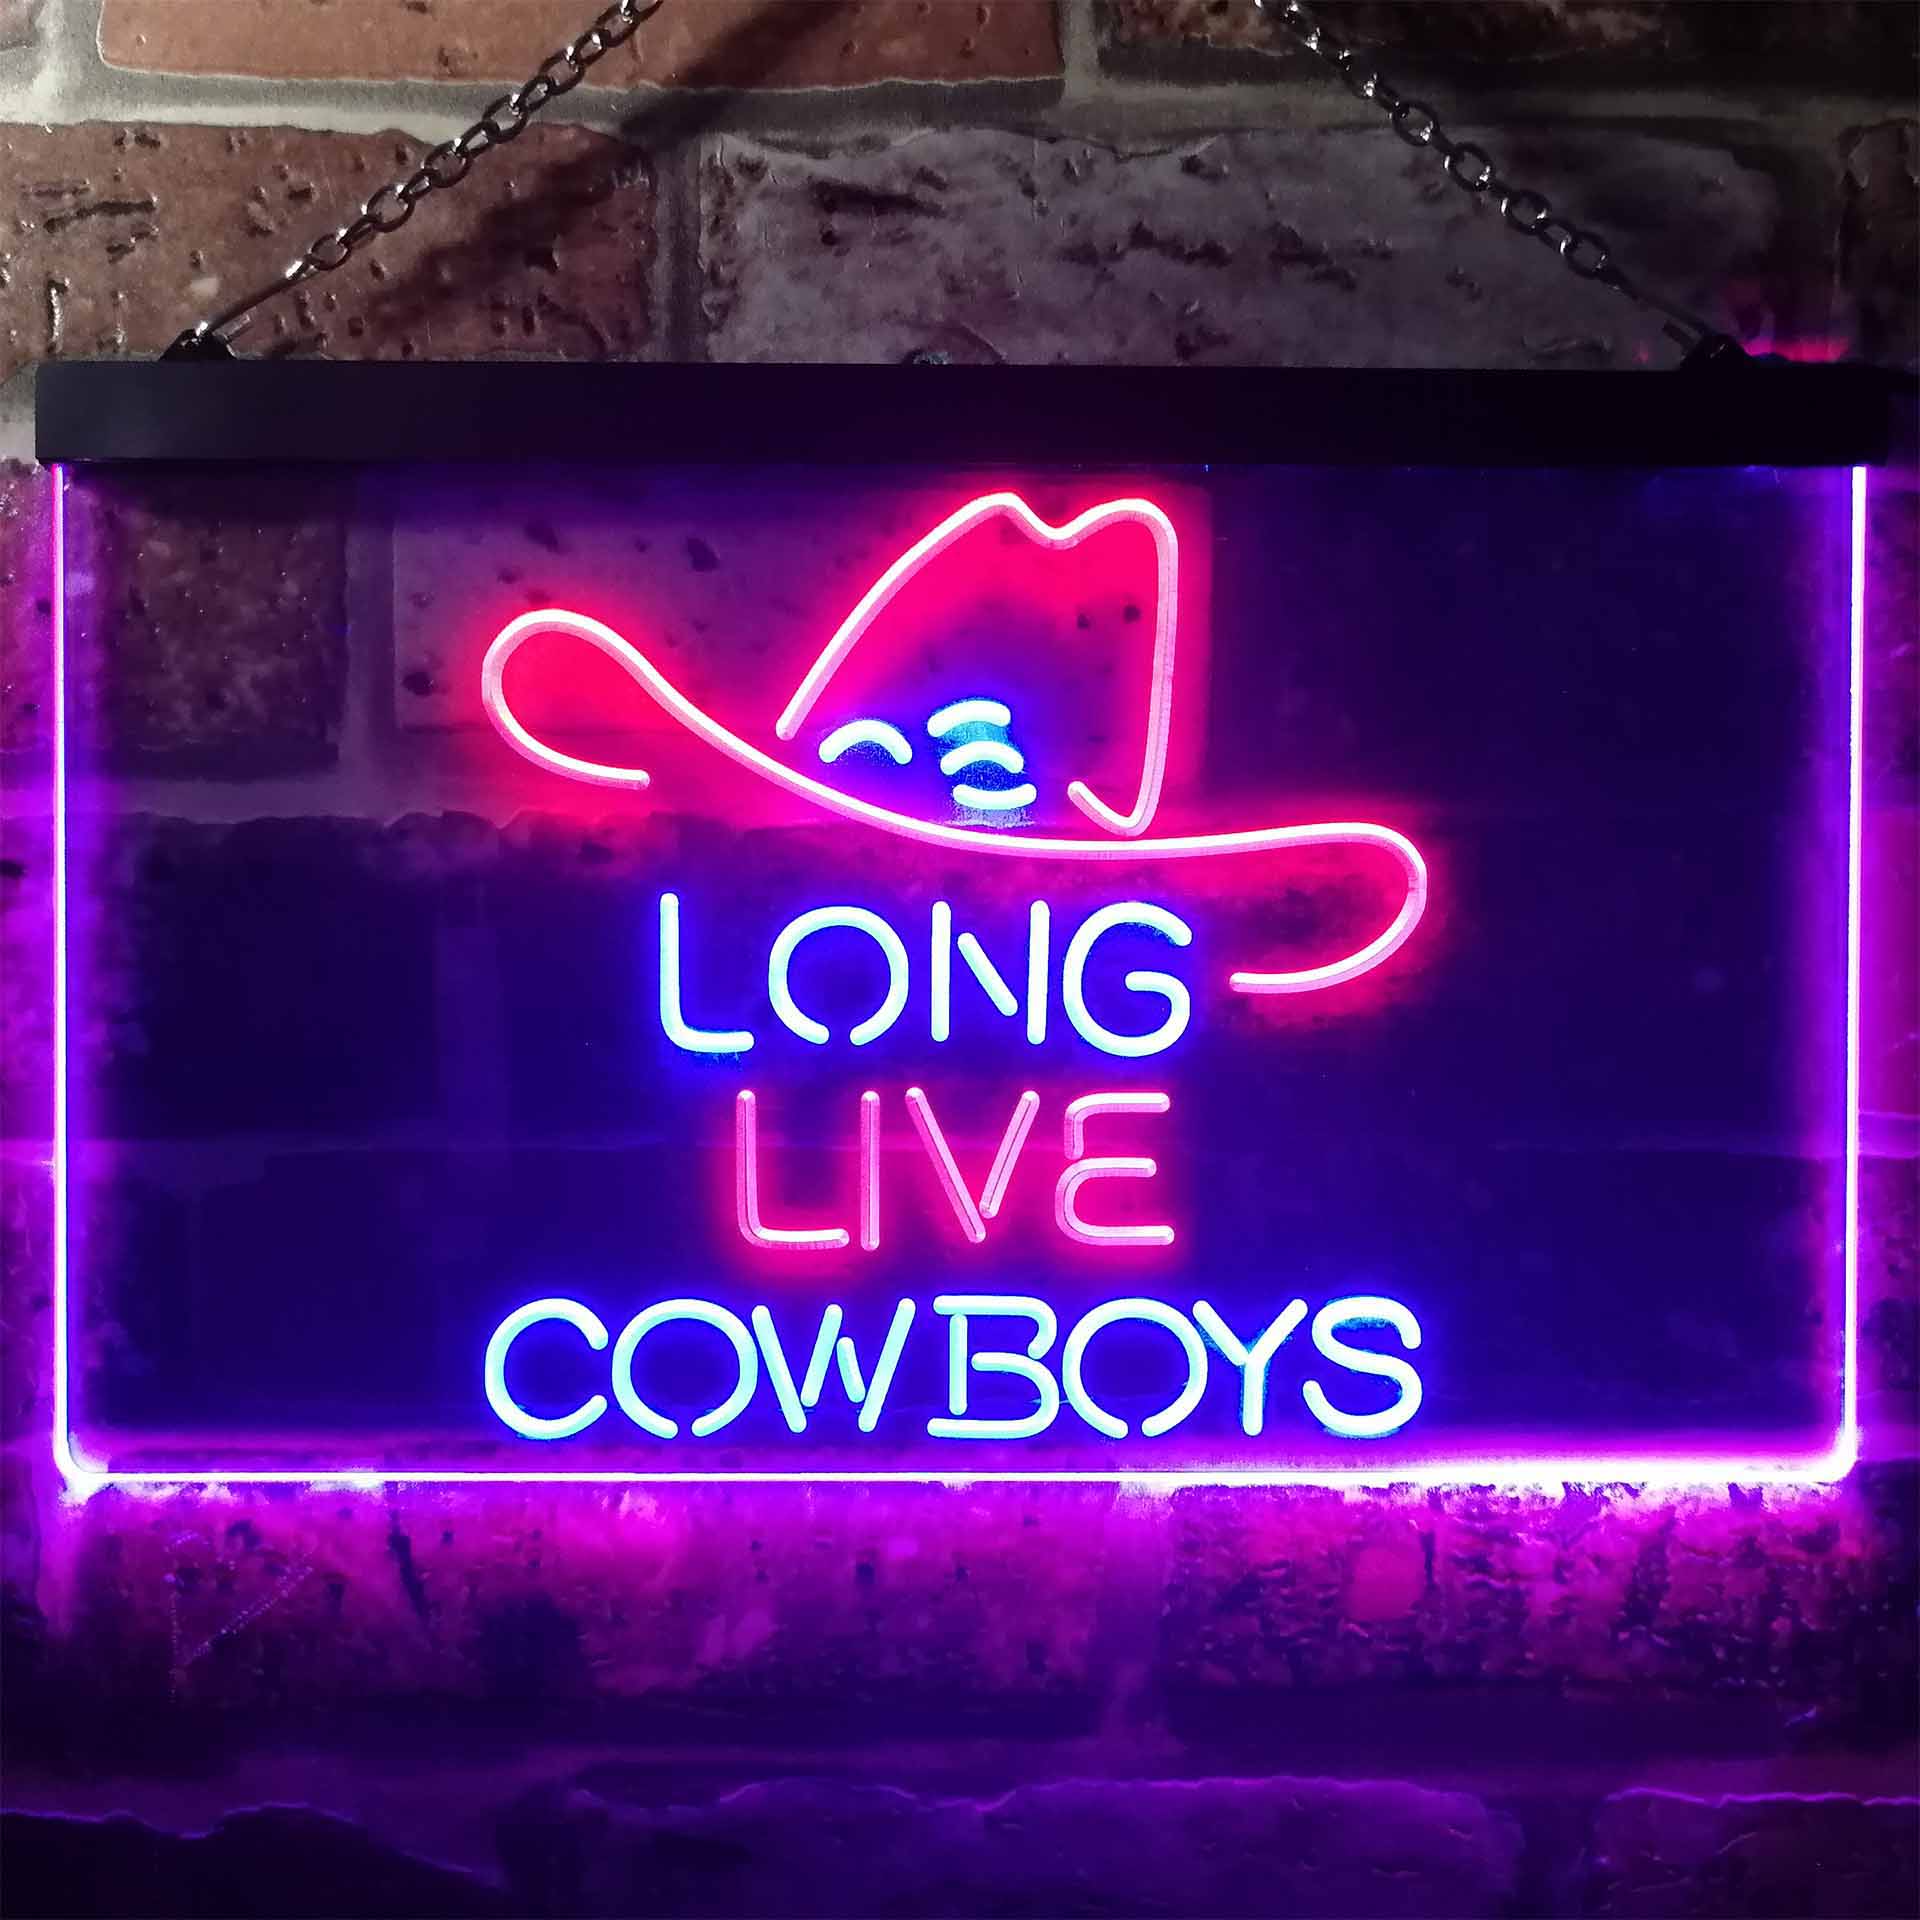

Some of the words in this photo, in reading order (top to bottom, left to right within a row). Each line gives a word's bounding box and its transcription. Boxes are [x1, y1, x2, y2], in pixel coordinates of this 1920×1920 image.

[659, 892, 1193, 1057] LONG
[735, 1087, 1175, 1251] LIVE
[484, 1295, 1424, 1439] COWBOYS
